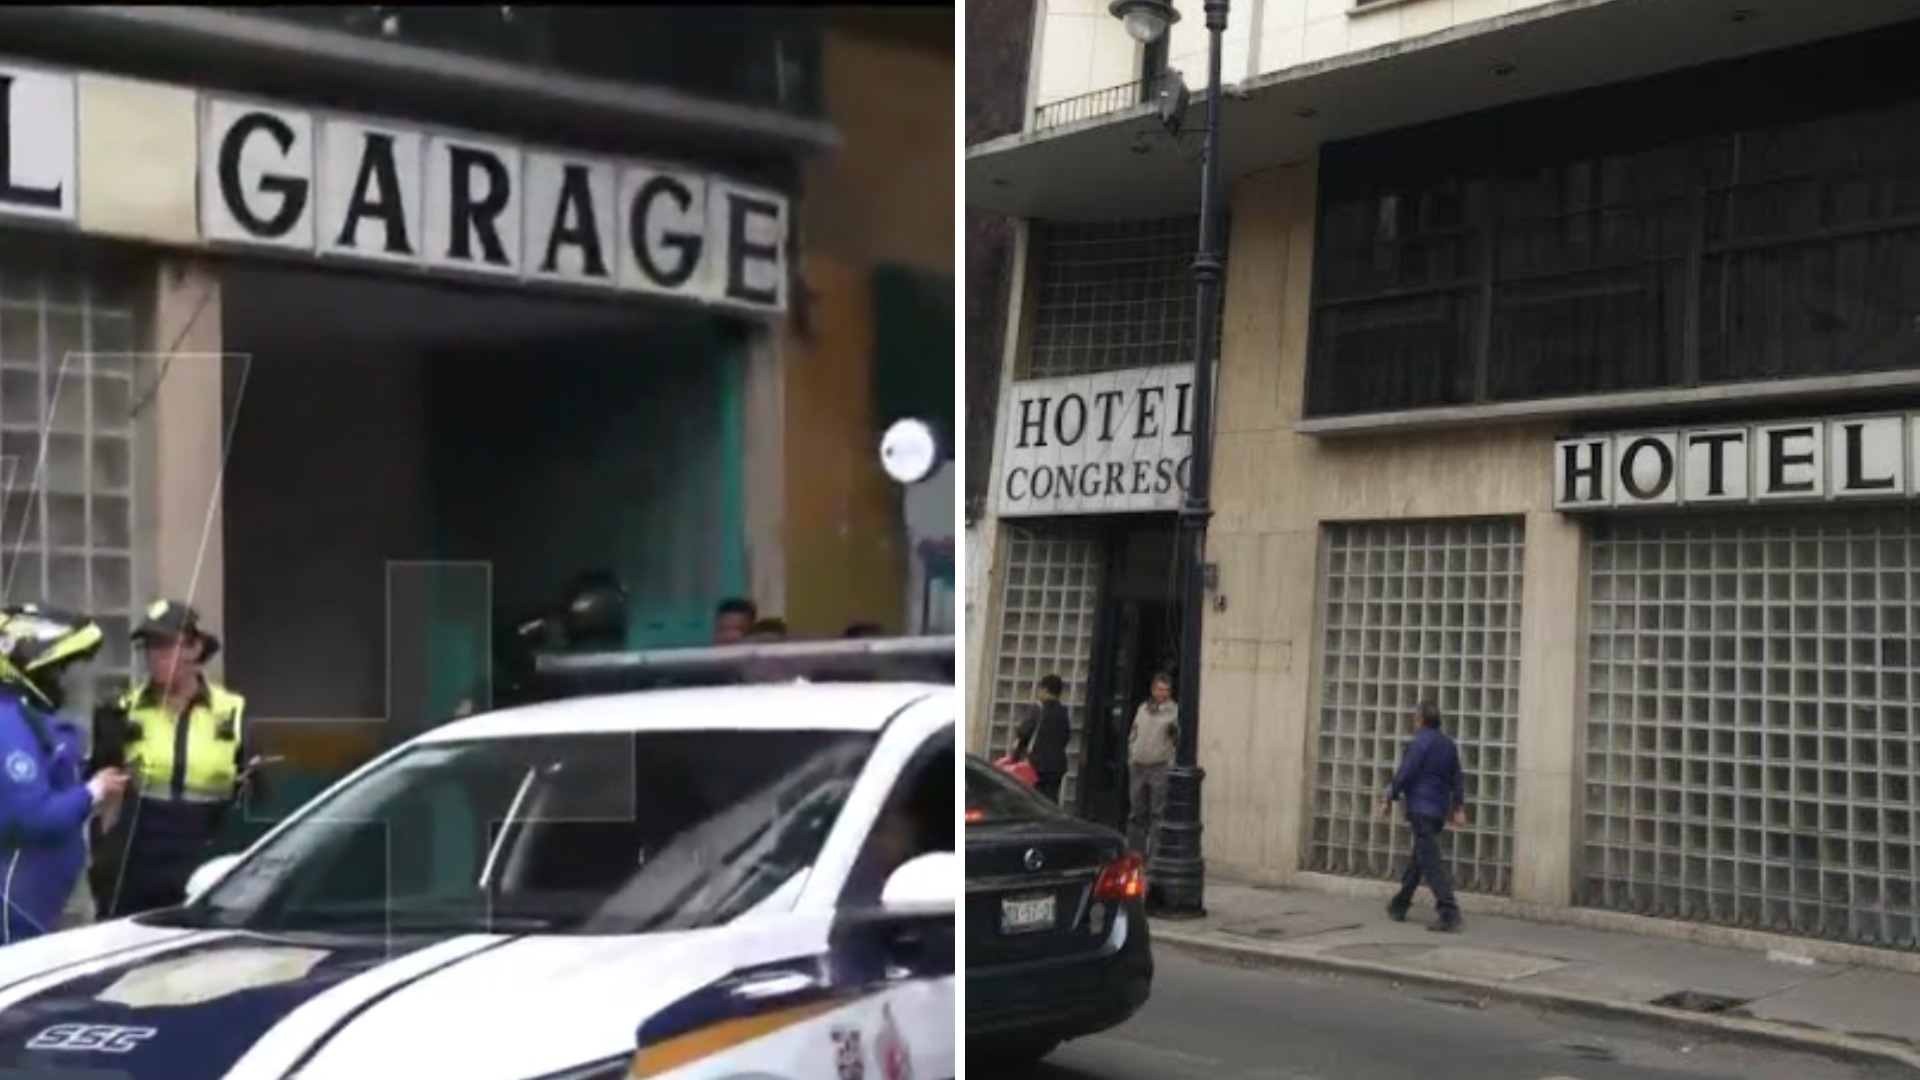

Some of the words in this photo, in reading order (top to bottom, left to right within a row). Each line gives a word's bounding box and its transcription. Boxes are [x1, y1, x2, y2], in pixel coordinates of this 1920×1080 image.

[217, 111, 779, 305] GARAGE
[1015, 383, 1193, 449] HOTEL
[1562, 424, 1895, 502] HOTEL
[25, 1022, 158, 1054] SSC
